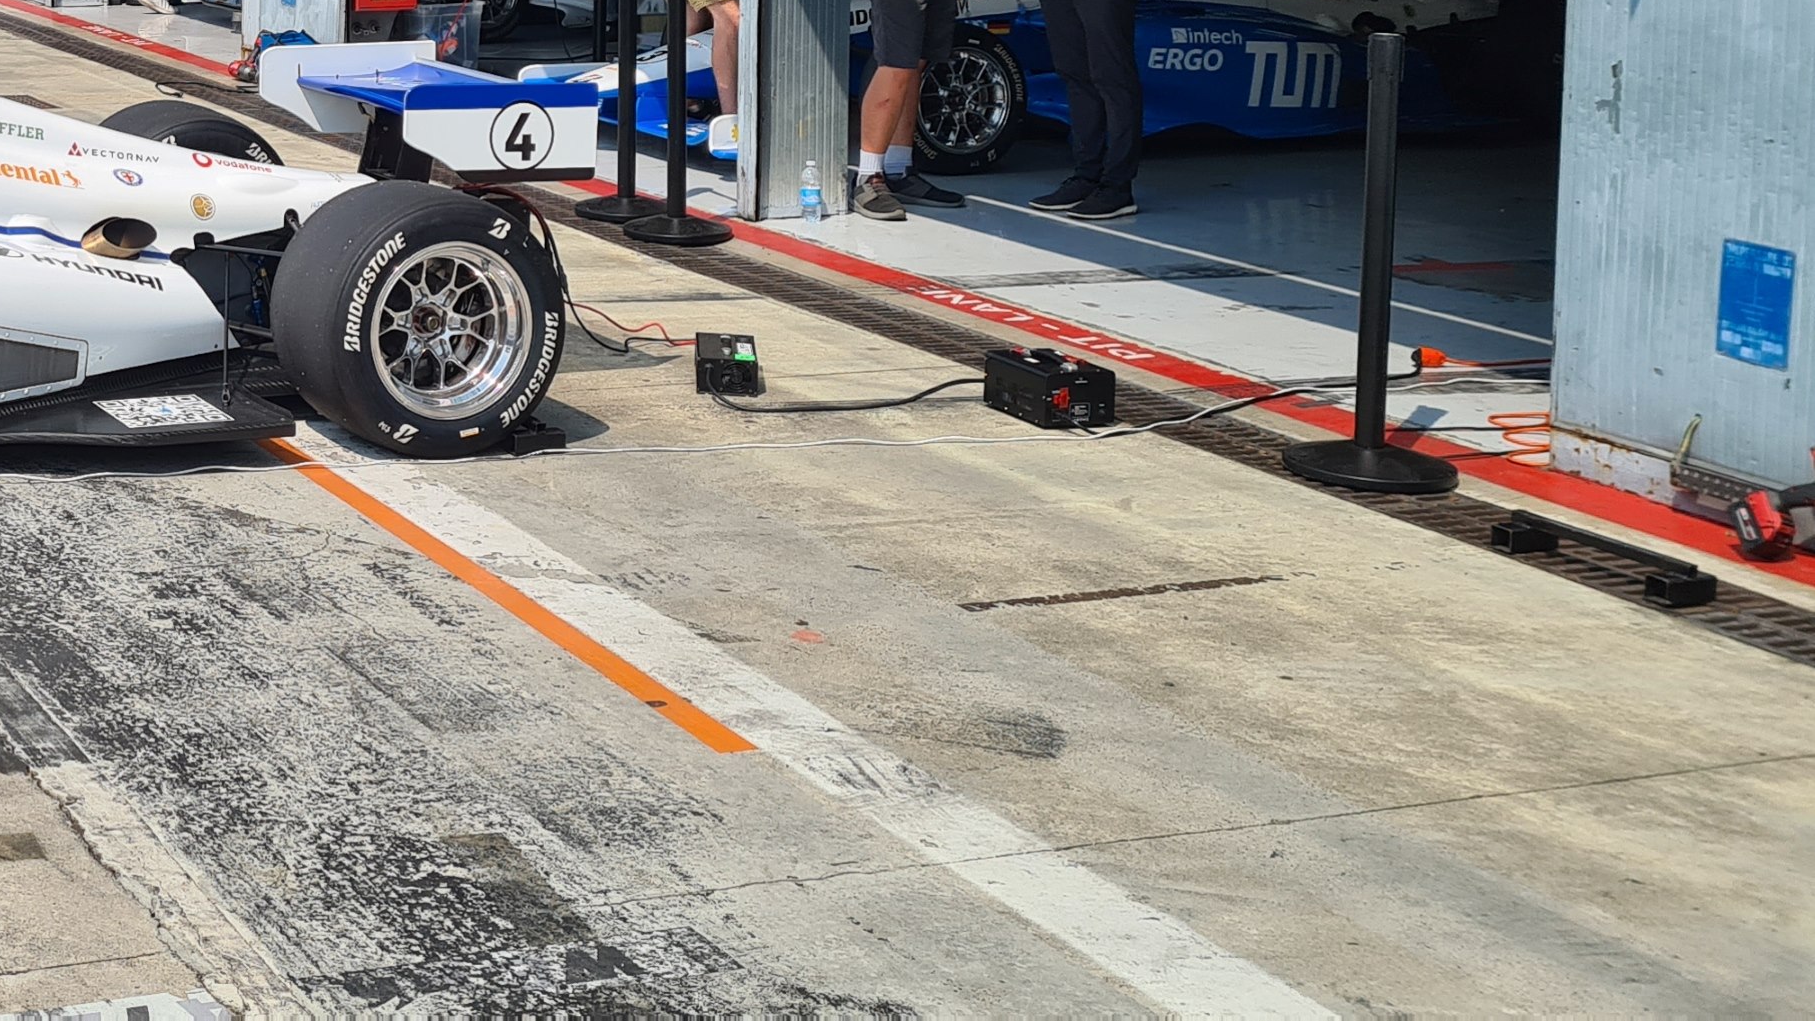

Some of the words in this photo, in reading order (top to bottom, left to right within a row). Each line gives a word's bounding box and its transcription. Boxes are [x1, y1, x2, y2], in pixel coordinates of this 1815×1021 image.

[1188, 29, 1243, 45] intech
[1147, 47, 1224, 72] ERGO
[505, 112, 536, 161] 4
[82, 146, 160, 164] VECTORNAV
[215, 157, 273, 174] vodafone
[32, 253, 164, 292] HYUNDAI
[344, 231, 408, 353] BRIDGESTONE
[908, 285, 1032, 324] LANE
[1058, 332, 1156, 362] PIT
[499, 311, 559, 428] BRIDGESTONE
